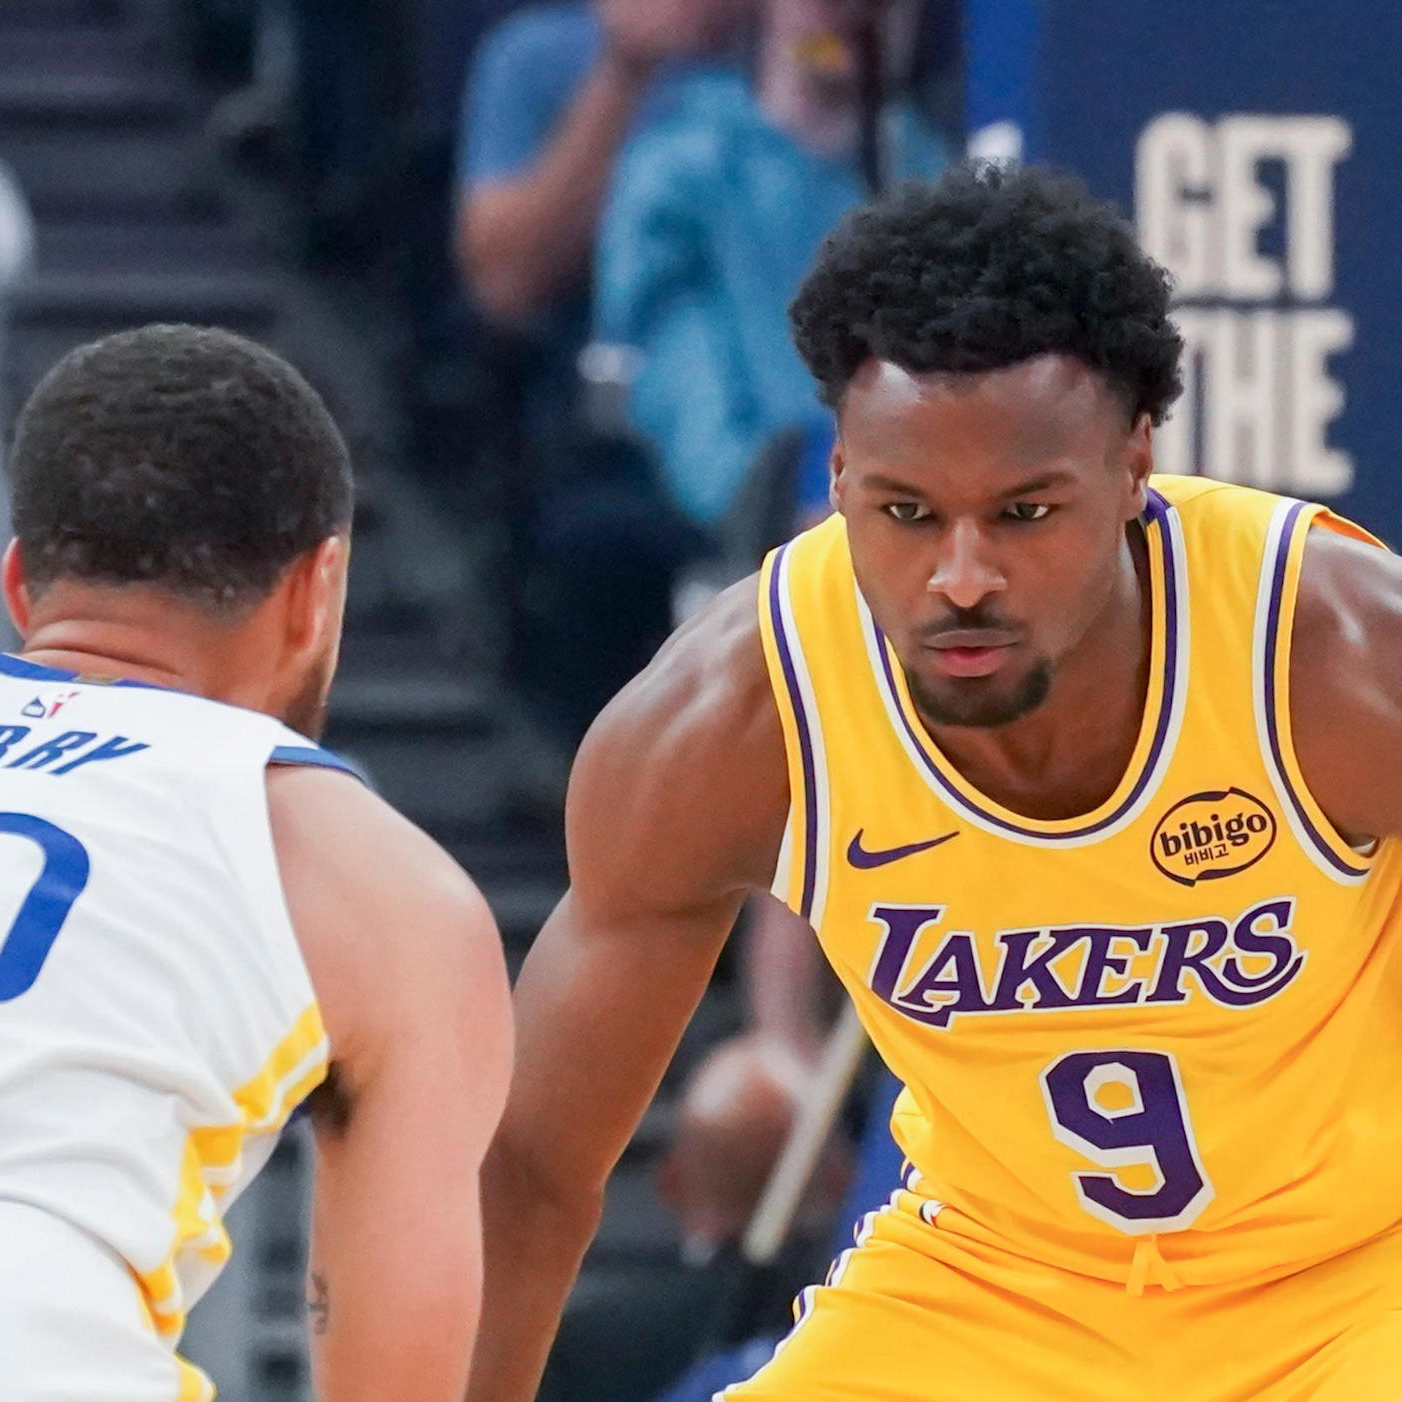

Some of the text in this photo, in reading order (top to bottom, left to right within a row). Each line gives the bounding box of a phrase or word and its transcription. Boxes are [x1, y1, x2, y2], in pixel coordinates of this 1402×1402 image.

[1133, 111, 1354, 300] GET
[1146, 307, 1356, 497] THE
[1159, 812, 1267, 857] bibigo
[1183, 843, 1230, 866] 비비고
[865, 896, 1308, 1031] LAKERS
[1038, 1047, 1216, 1236] 9
